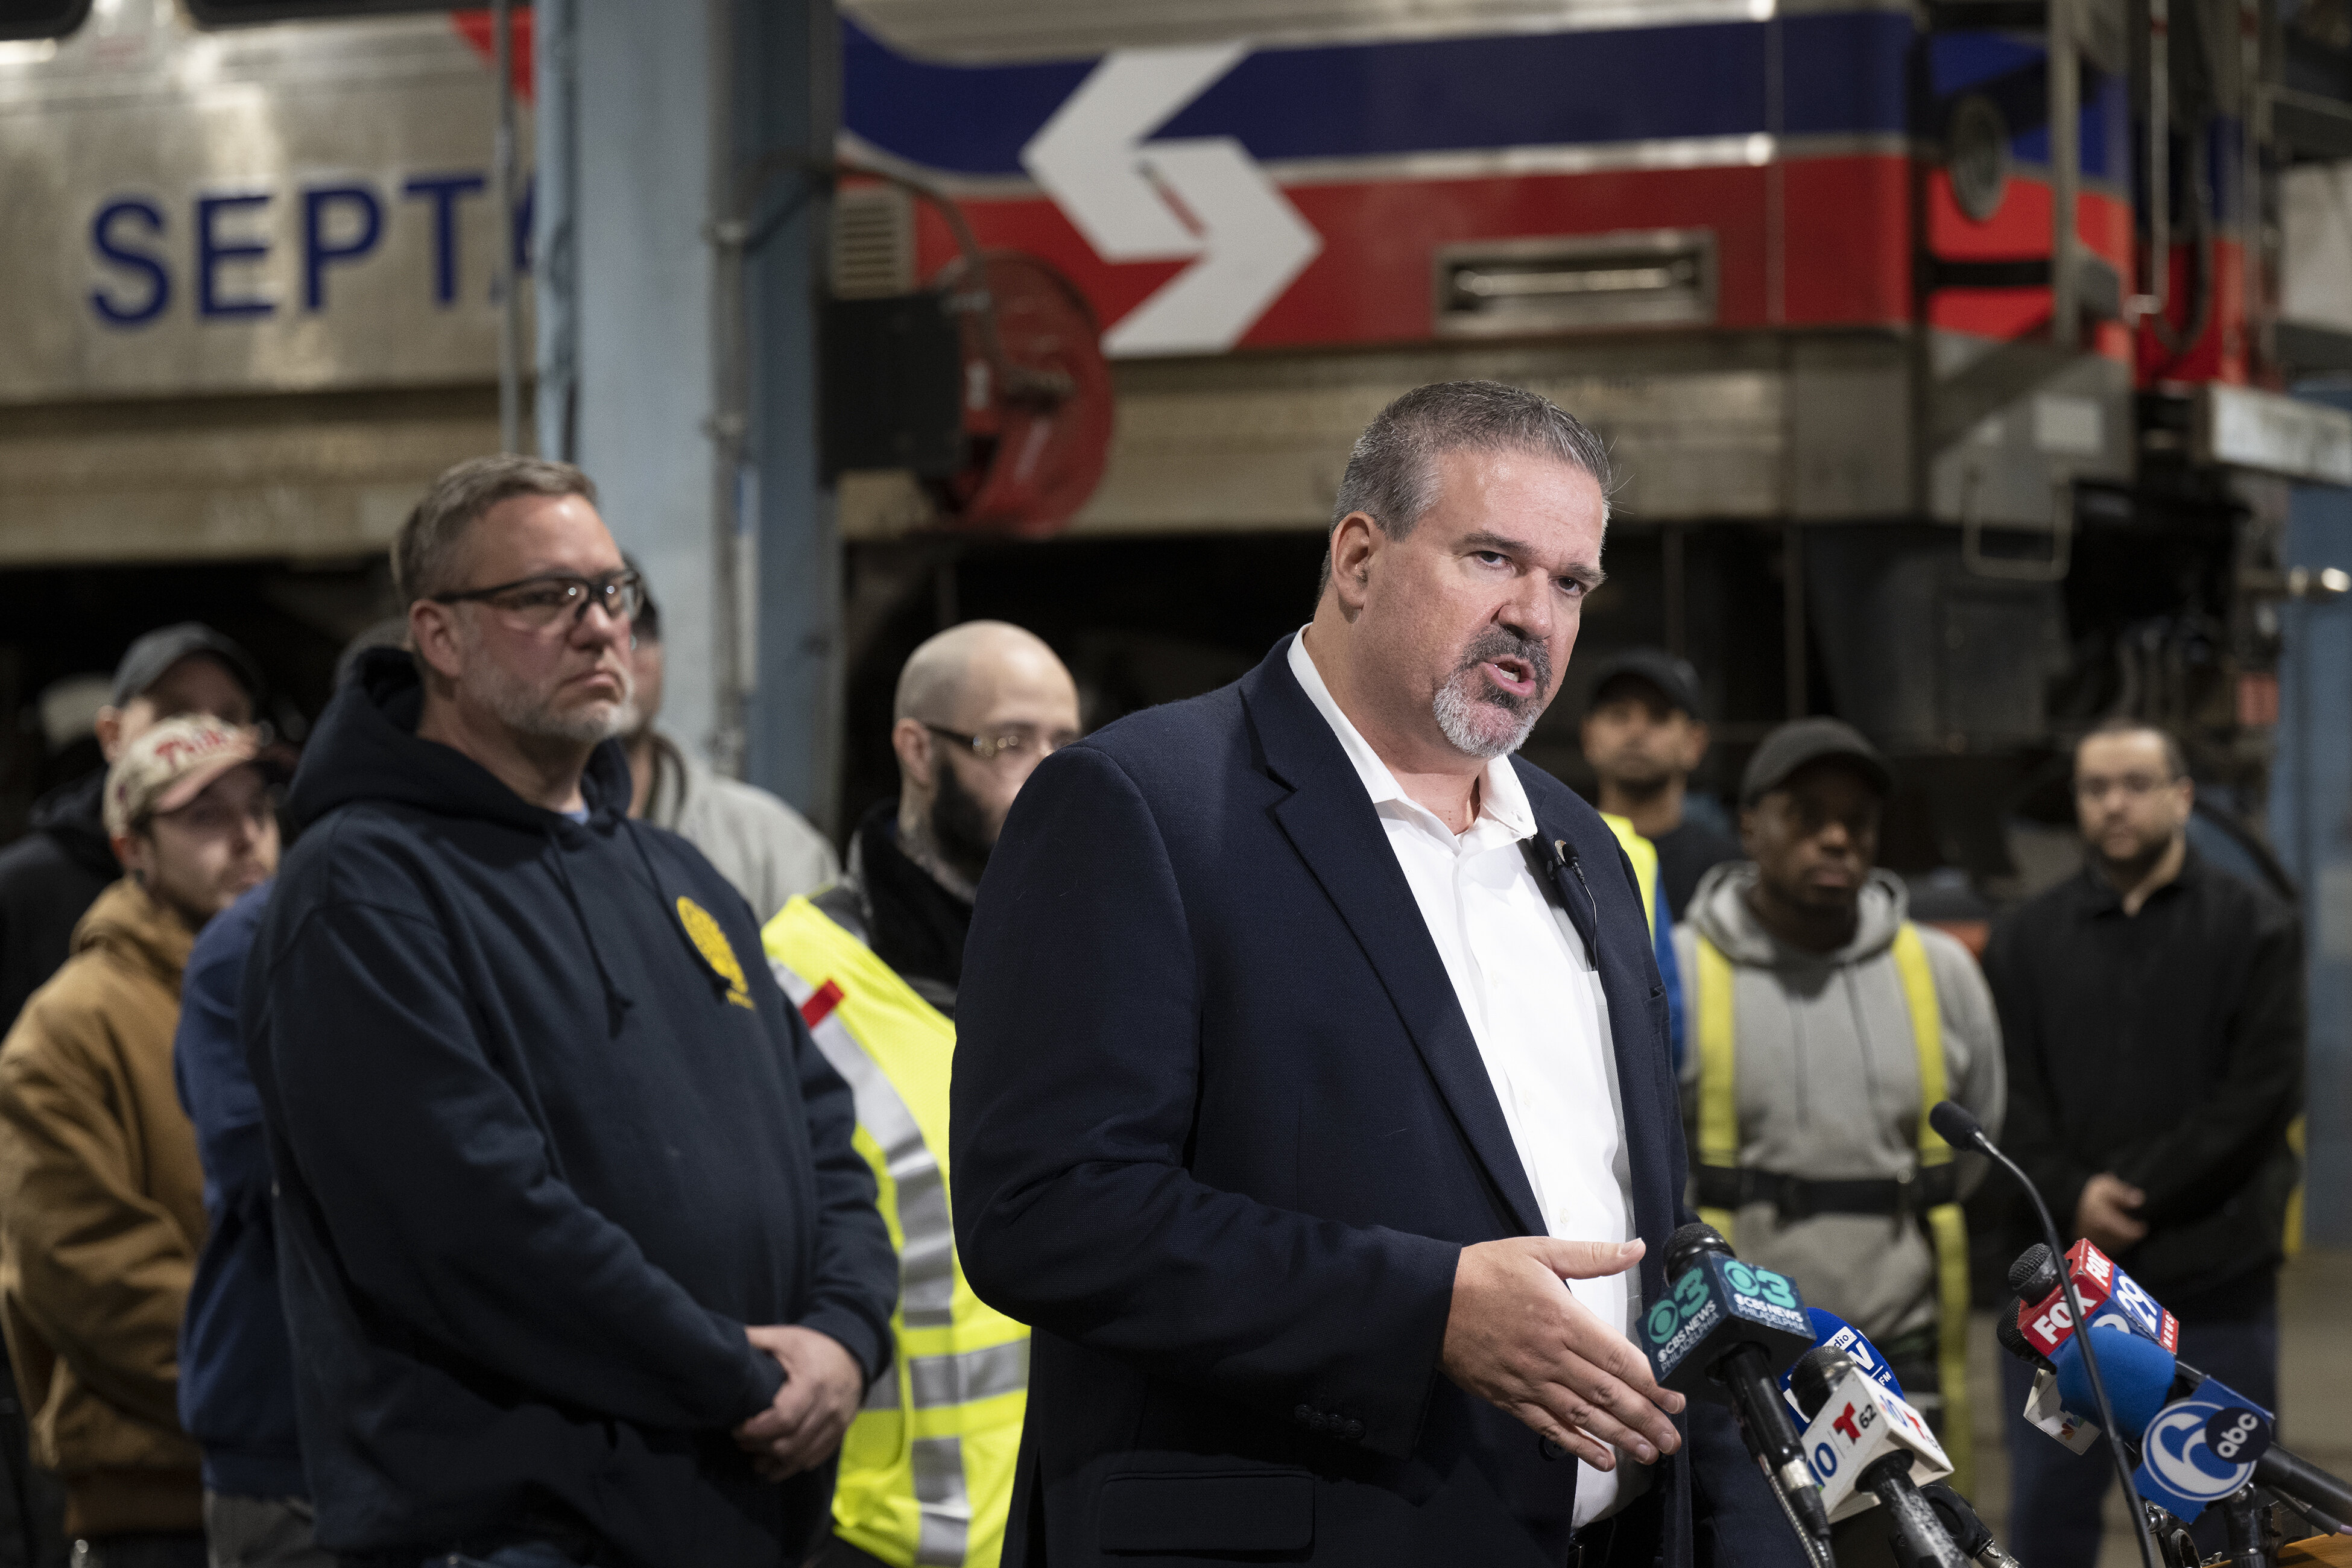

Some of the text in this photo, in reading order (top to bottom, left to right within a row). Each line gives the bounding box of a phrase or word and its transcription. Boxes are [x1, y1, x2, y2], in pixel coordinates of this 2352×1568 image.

[2085, 1246, 2110, 1287] FOX
[1737, 1304, 1807, 1332] PHILADELPHIA
[1743, 1297, 1803, 1323] CBS NEWS
[2117, 1276, 2157, 1333] 29
[1660, 1312, 1719, 1373] PHILADELPHIA
[1666, 1300, 1716, 1355] CBS NEWS
[2163, 1314, 2175, 1348] NEWS
[1878, 1371, 1892, 1386] FM
[1859, 1404, 1877, 1429] 62
[2217, 1413, 2258, 1458] abc
